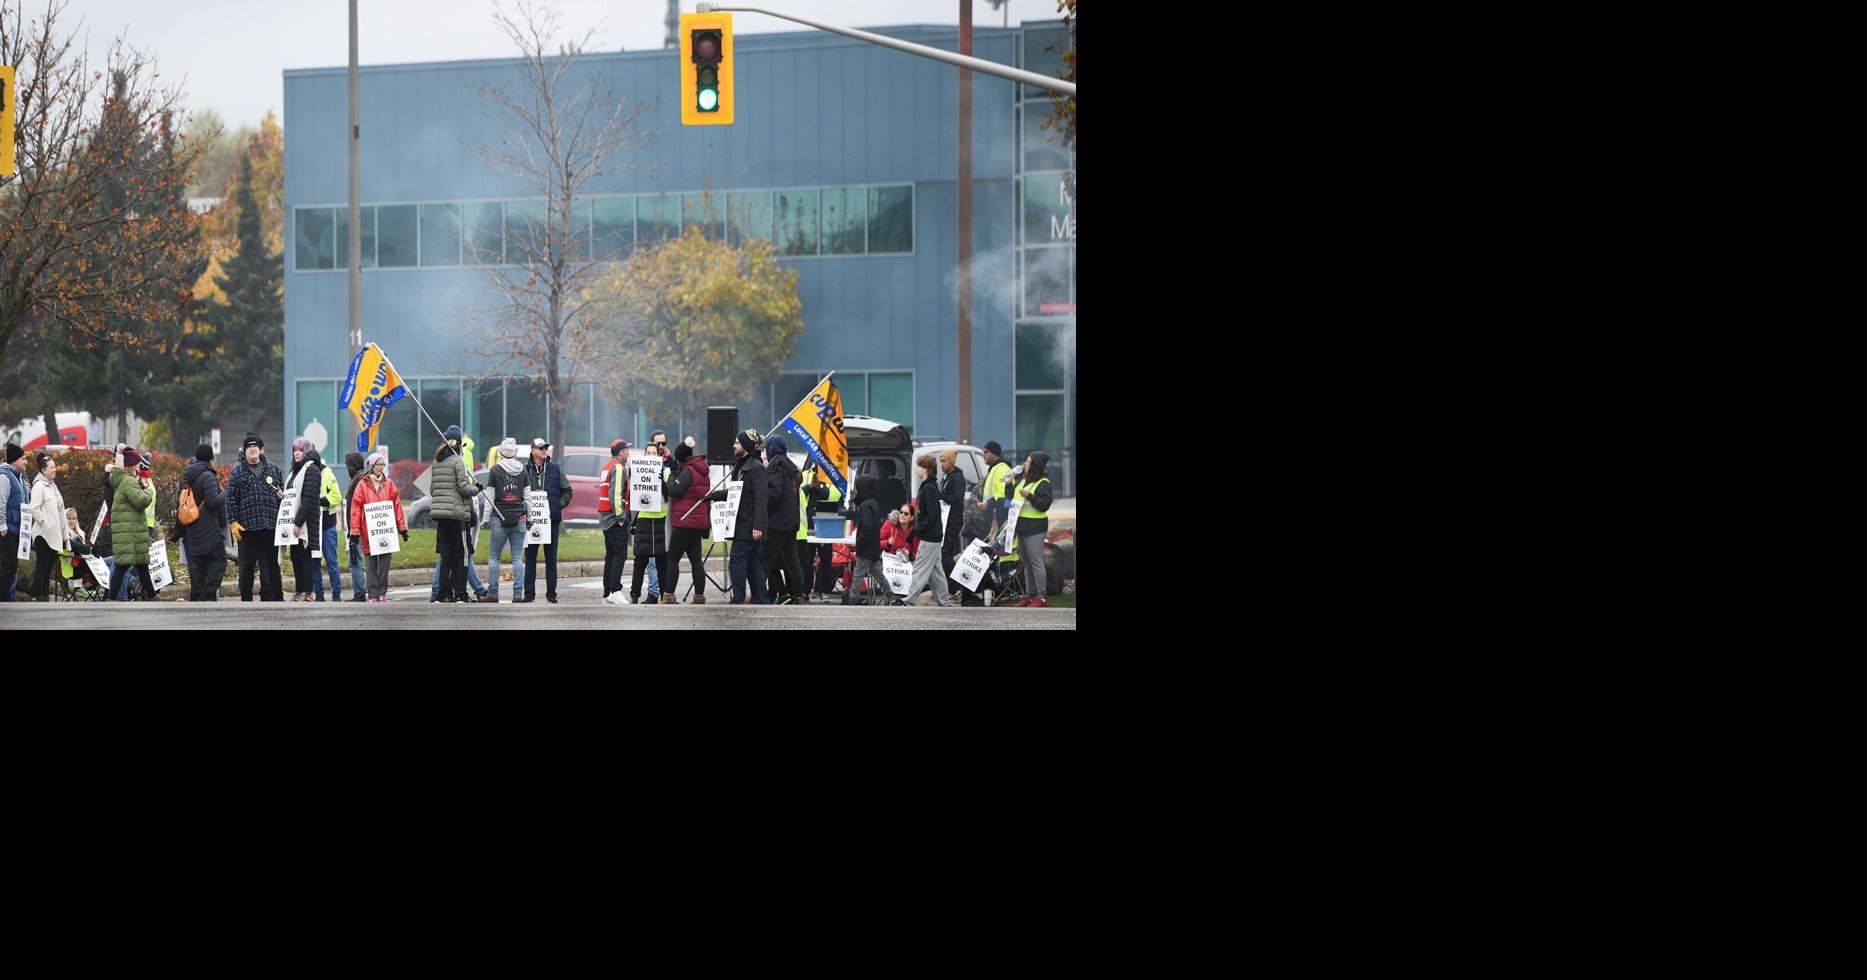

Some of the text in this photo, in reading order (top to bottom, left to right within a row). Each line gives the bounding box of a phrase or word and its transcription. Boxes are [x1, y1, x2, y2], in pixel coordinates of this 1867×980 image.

[350, 328, 361, 346] 11
[793, 424, 809, 440] Local
[806, 437, 819, 453] 548
[633, 484, 658, 492] STRIKE
[365, 504, 393, 513] HAMILTON
[376, 520, 387, 528] ON
[370, 527, 395, 537] STRIKE
[149, 561, 166, 574] TRIKE
[961, 558, 984, 574] STRIKE
[885, 567, 911, 576] STRIKE
